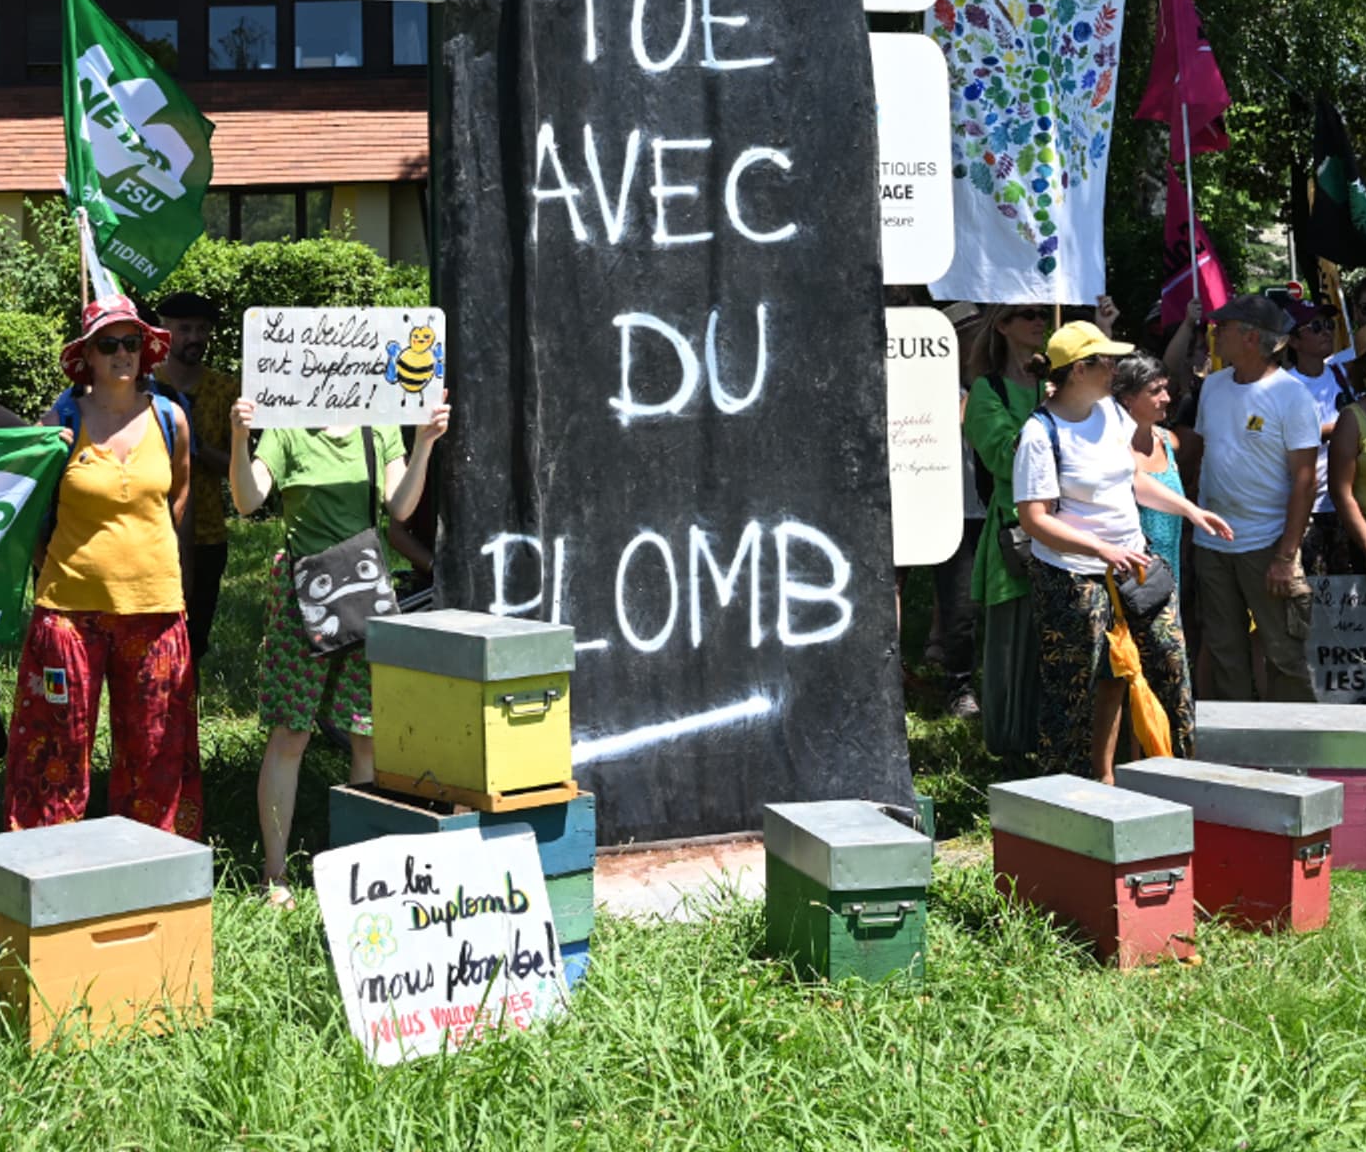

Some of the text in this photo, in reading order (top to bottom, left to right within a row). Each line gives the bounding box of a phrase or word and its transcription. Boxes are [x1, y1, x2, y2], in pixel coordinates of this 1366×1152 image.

[115, 178, 165, 213] FSU
[532, 124, 796, 246] AVEC
[878, 184, 914, 200] AGE
[263, 312, 379, 350] Les abeilles
[257, 350, 292, 375] ont
[609, 303, 767, 425] DU
[255, 386, 302, 409] dans
[481, 515, 853, 652] PLOMB
[1325, 669, 1365, 691] LES
[350, 854, 440, 905] La loi
[403, 871, 530, 937] Duplomb
[360, 962, 434, 1004] nous
